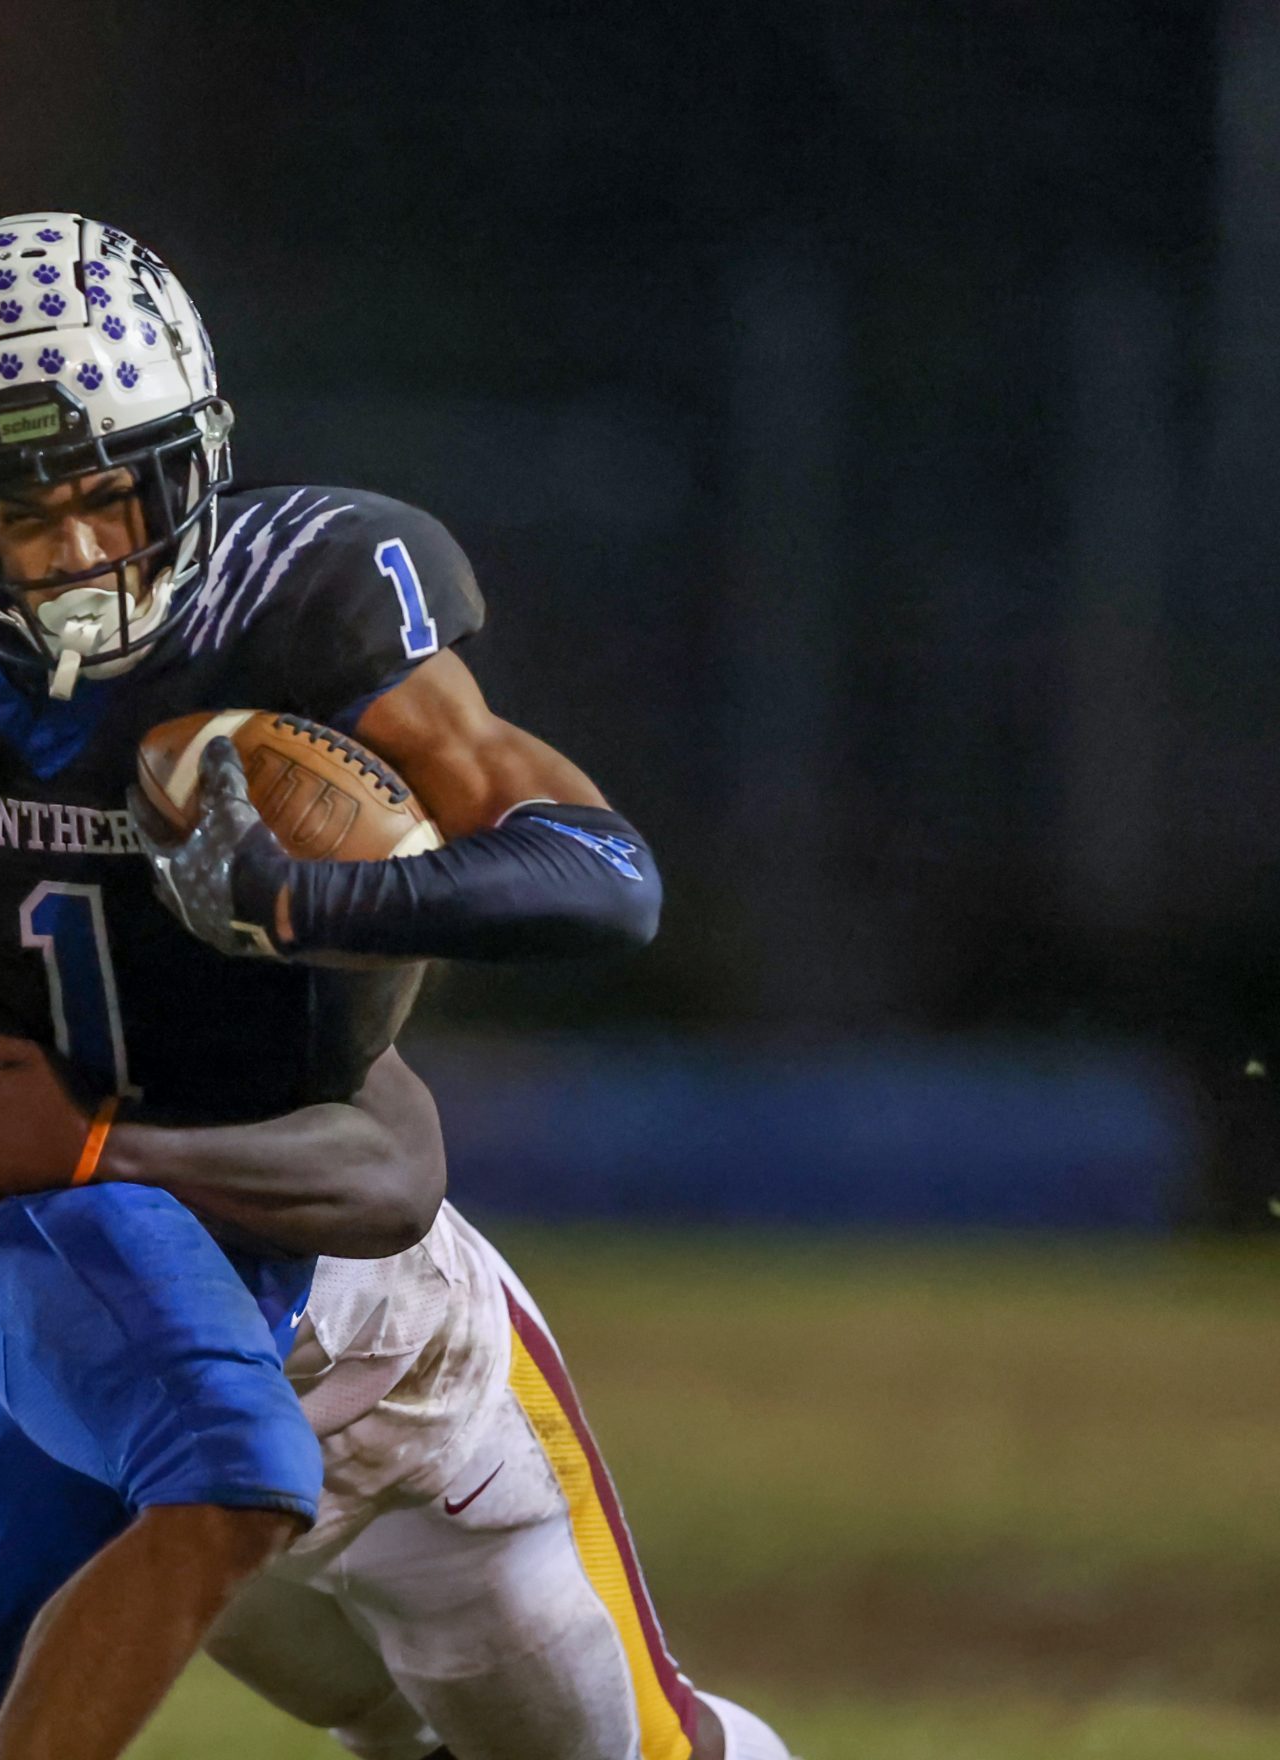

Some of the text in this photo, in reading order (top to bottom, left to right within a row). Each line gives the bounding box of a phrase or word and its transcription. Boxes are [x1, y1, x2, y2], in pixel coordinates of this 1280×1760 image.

[0, 411, 58, 436] schutt
[374, 537, 438, 659] 1
[20, 879, 145, 1098] 1
